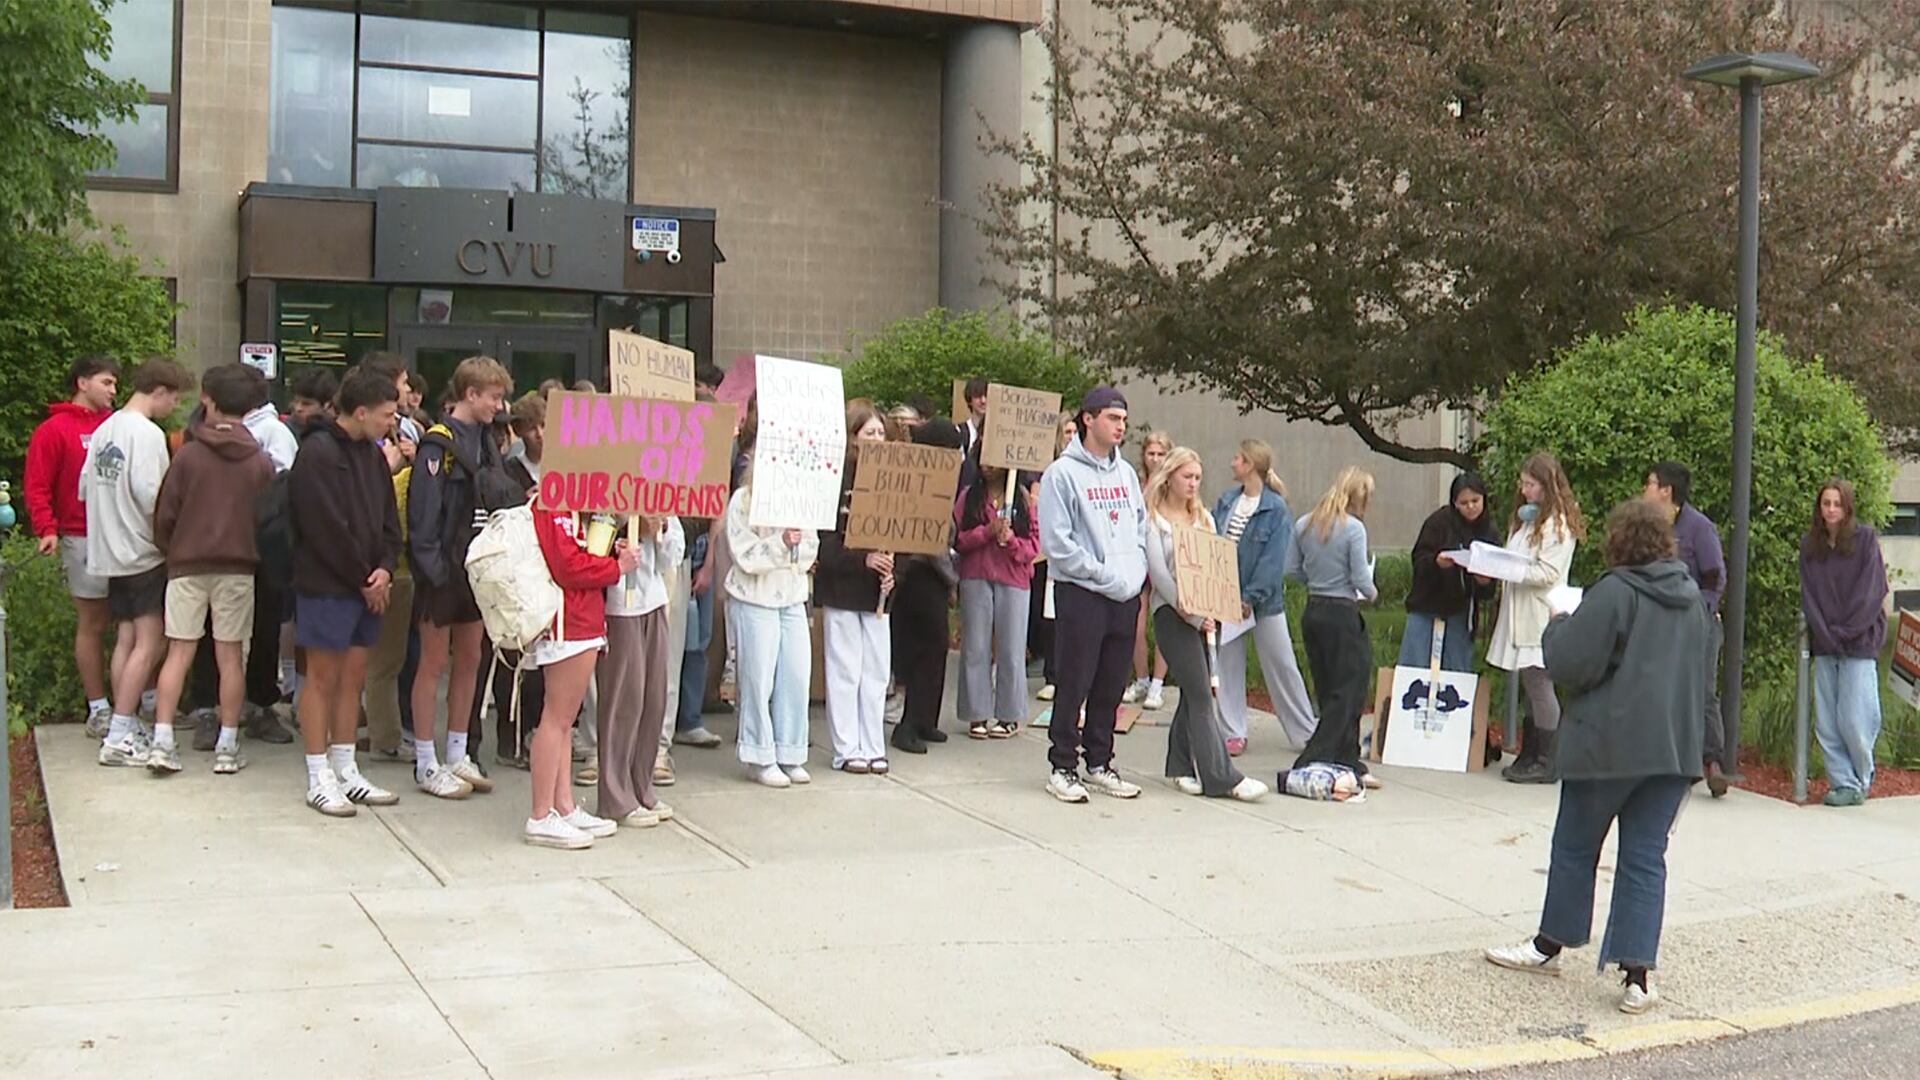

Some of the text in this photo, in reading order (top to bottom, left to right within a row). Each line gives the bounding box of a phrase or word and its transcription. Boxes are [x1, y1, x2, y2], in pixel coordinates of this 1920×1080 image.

[642, 219, 669, 231] NOTICE
[457, 240, 558, 278] CVU
[616, 342, 691, 379] NO HUMAN
[616, 373, 632, 397] IS
[1001, 386, 1046, 407] Borders
[559, 395, 715, 447] HANDS
[639, 446, 706, 485] OFF
[861, 443, 958, 471] IMMIGRANTS
[1006, 443, 1041, 462] REAL
[541, 470, 728, 516] OUR STUDENTS
[874, 469, 930, 496] BUILT
[874, 493, 919, 515] THIS
[1178, 530, 1230, 582] ALL ARE
[1179, 569, 1241, 622] WELCOME
